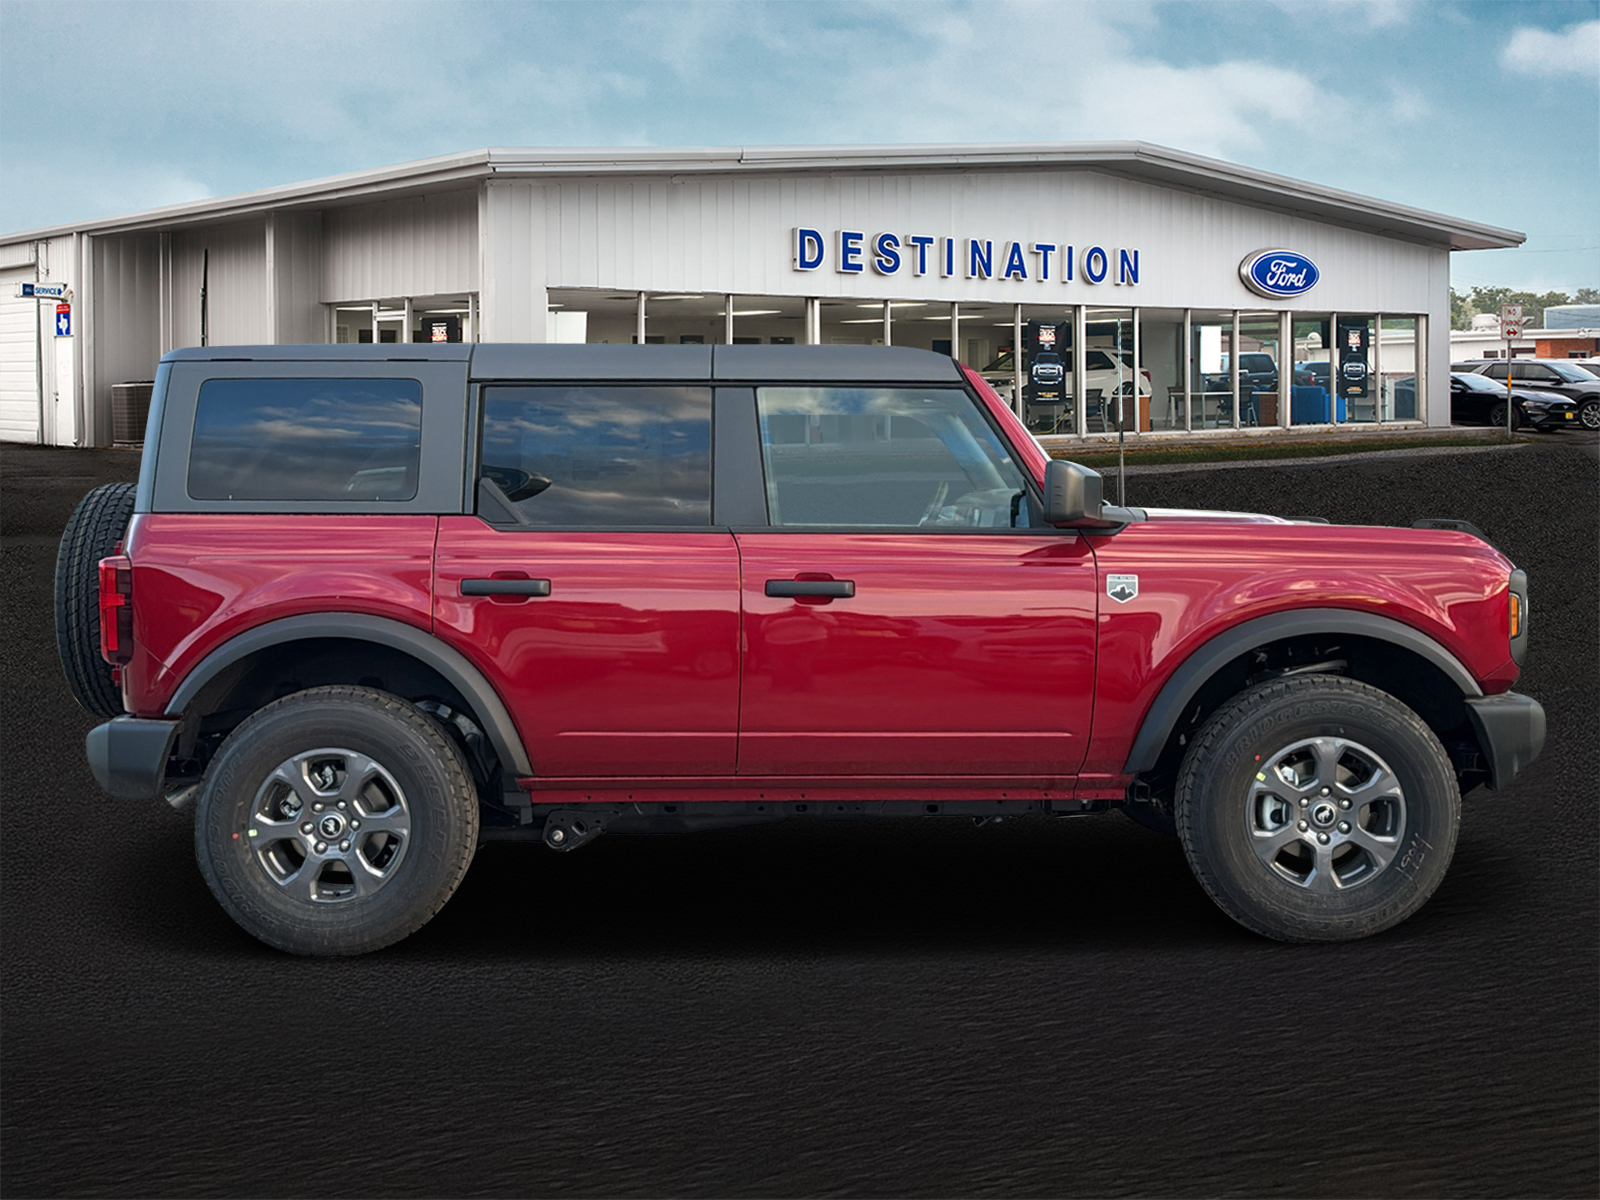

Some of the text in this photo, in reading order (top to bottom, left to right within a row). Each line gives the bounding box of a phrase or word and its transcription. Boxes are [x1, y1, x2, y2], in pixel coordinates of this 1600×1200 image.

[792, 227, 1140, 286] DESTINATION
[1266, 259, 1307, 287] Ford
[35, 286, 57, 295] SERVICE
[1224, 700, 1401, 774] BRIDGESTONE
